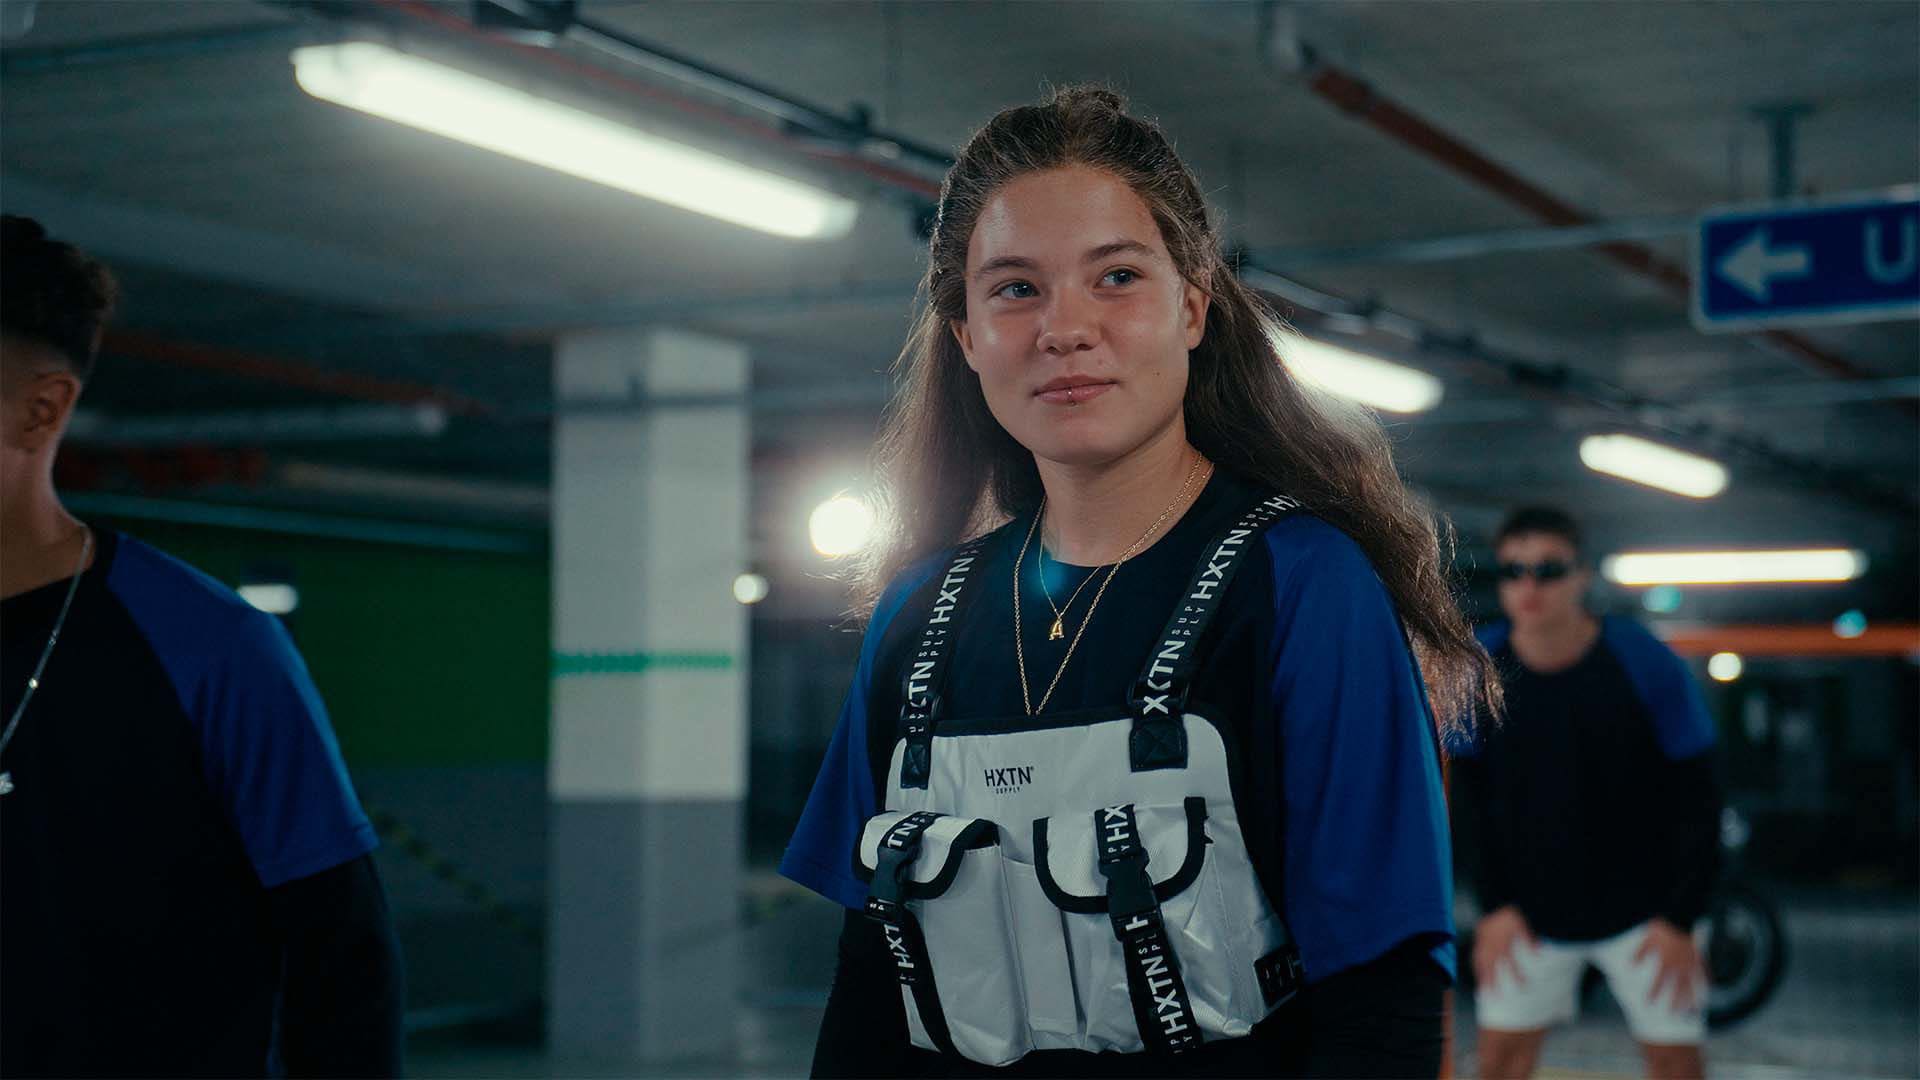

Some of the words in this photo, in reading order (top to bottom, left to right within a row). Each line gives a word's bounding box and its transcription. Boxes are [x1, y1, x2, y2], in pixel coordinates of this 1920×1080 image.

[928, 557, 975, 625] HXTN
[1190, 529, 1253, 600] HXTN
[984, 766, 1032, 787] HXTN
[887, 822, 919, 848] TN
[1103, 804, 1130, 843] HX
[1141, 955, 1188, 1035] HXTN
